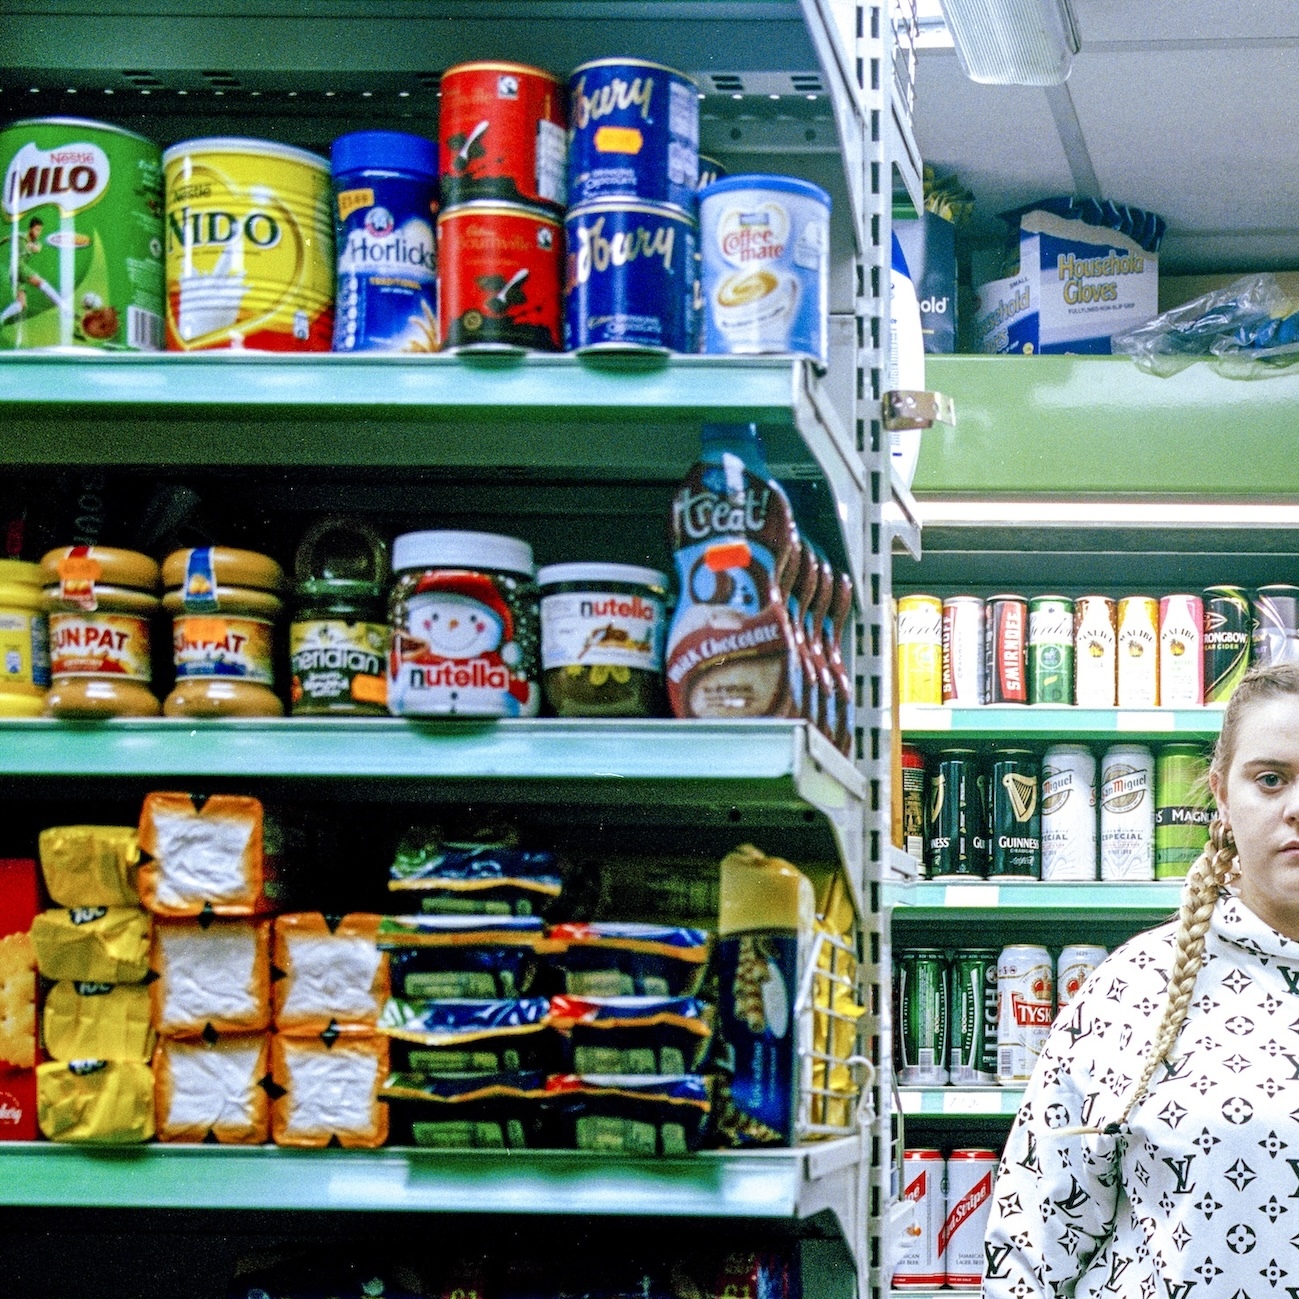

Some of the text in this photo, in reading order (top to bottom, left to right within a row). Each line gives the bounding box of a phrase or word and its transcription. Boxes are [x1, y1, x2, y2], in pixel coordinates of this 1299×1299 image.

[11, 165, 98, 199] MILO
[167, 208, 280, 255] NIDO
[722, 230, 772, 256] Coffee
[739, 242, 785, 262] mate
[1057, 250, 1144, 280] Household
[1010, 277, 1029, 288] SMALL
[1063, 281, 1118, 305] Gloves
[580, 598, 653, 622] nutella
[84, 628, 129, 650] PAT
[410, 659, 510, 690] nutella
[1115, 774, 1147, 793] Miguel
[999, 836, 1039, 849] GUINNESS
[955, 1183, 987, 1221] Stripe
